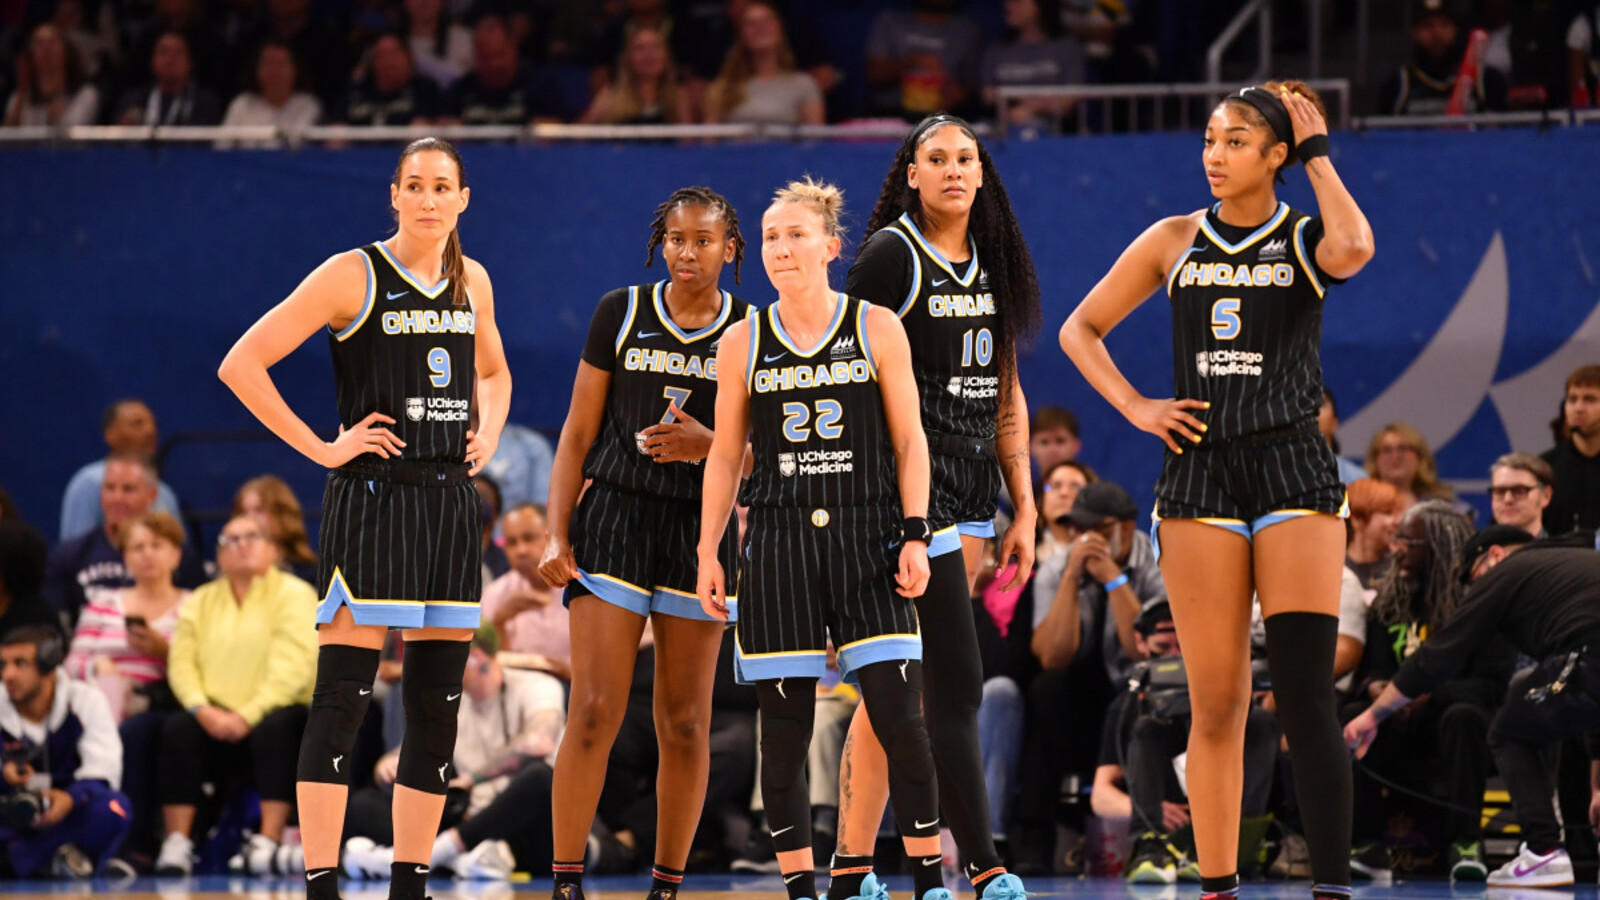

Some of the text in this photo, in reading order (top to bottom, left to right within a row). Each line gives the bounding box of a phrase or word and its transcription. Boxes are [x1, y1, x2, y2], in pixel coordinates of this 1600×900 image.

[928, 292, 998, 318] CHICAG
[1211, 298, 1242, 340] 5
[961, 327, 993, 367] 10
[1208, 350, 1263, 364] UChicago
[427, 347, 451, 388] 9
[624, 347, 718, 381] CHICAG
[755, 359, 870, 393] CHICAGO
[1210, 362, 1263, 377] Medicine
[427, 397, 469, 410] UChicag
[660, 386, 692, 424] 7
[962, 387, 998, 399] Medicin
[426, 409, 469, 422] Medicin
[782, 399, 844, 442] 22
[797, 450, 853, 463] UChicago
[799, 462, 853, 476] Medicine
